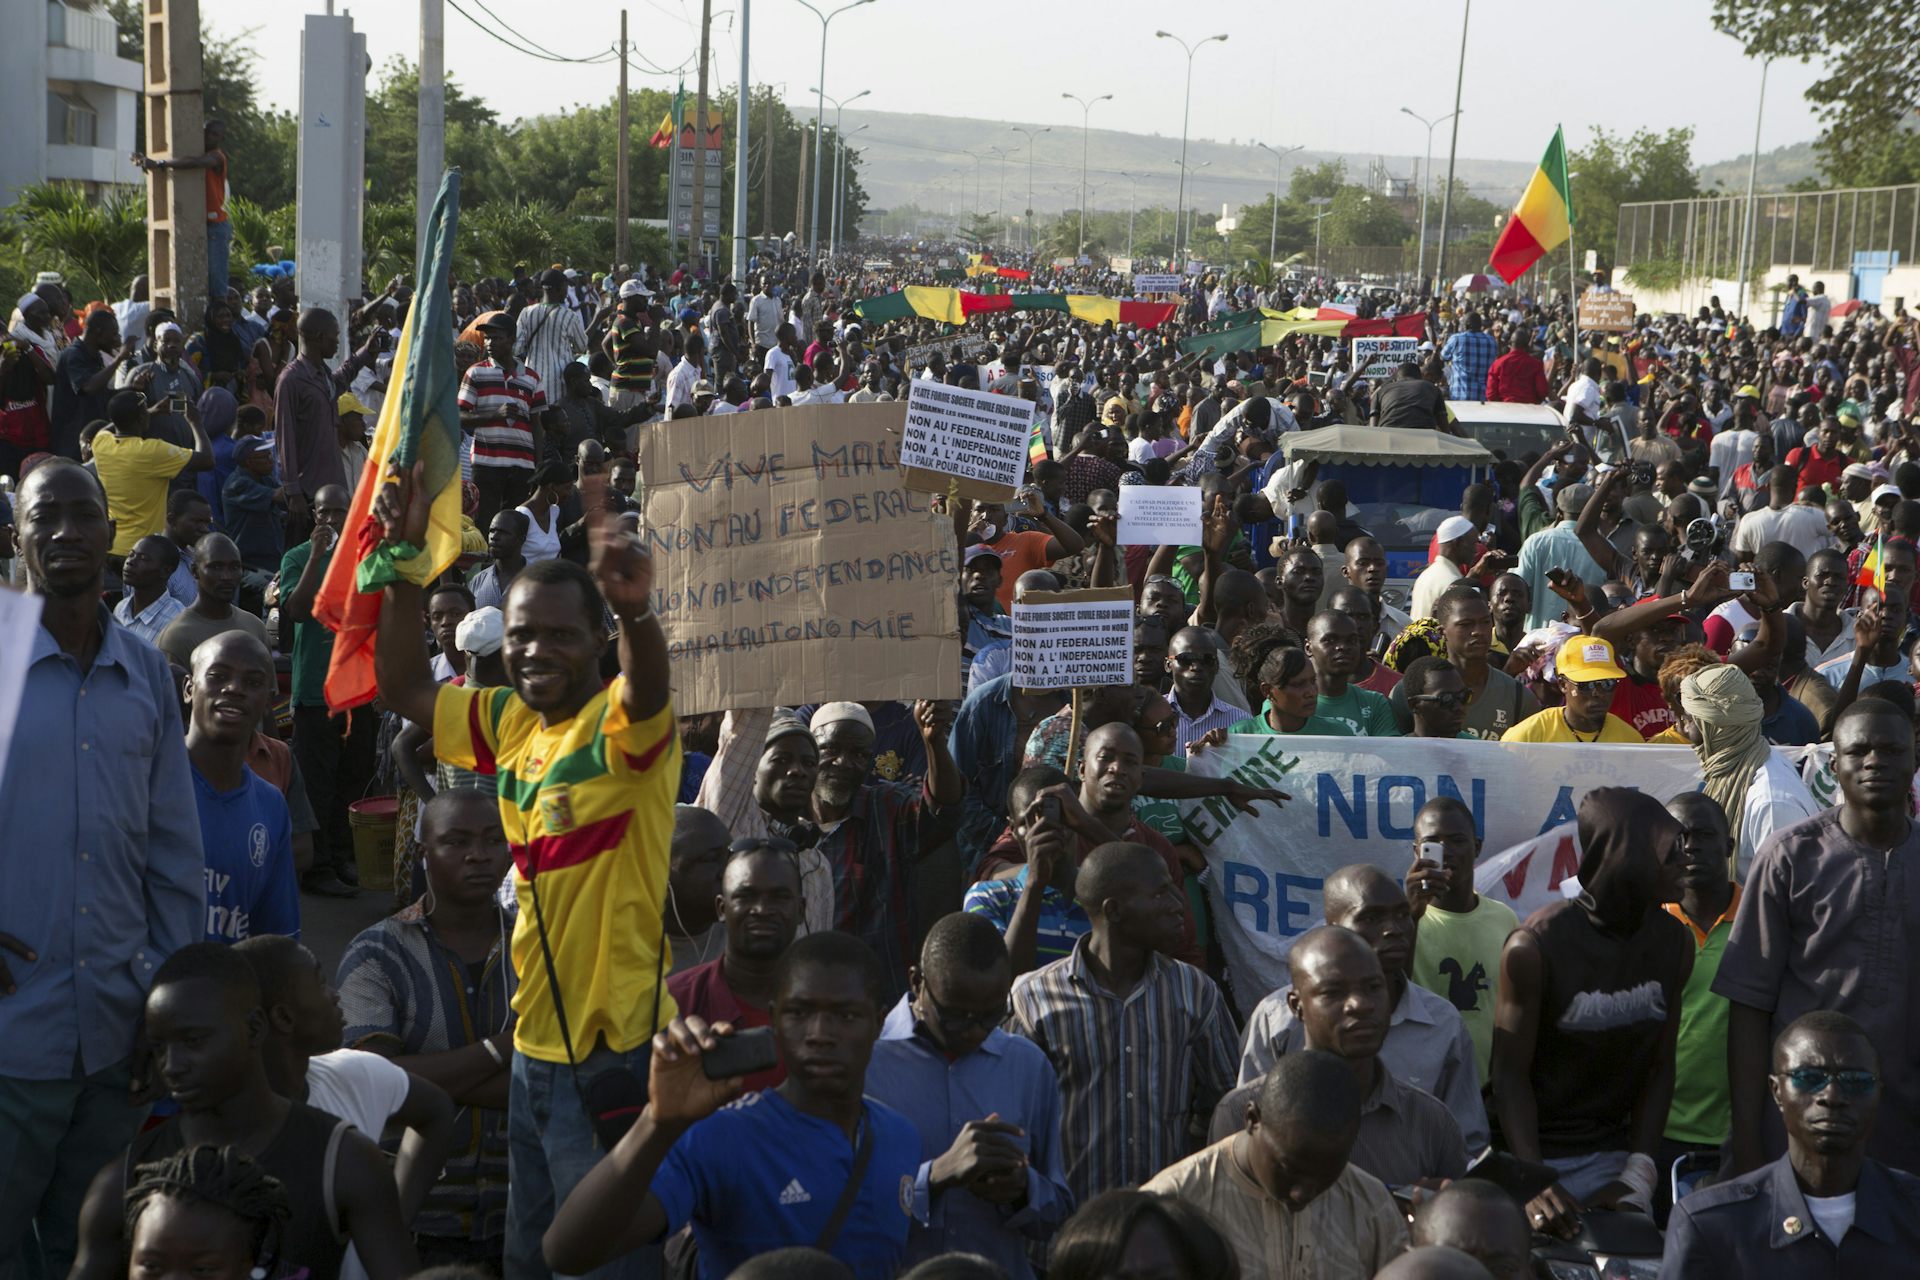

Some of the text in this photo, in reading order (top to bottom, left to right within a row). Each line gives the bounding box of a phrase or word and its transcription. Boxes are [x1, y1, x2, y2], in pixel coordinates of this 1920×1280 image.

[1357, 341, 1379, 352] PAS
[1379, 341, 1390, 352] DE
[1366, 367, 1387, 376] NORD
[913, 386, 931, 400] PLATE
[976, 399, 996, 413] CIVILE
[908, 414, 1022, 448] NON AU FEDERALISME
[946, 409, 957, 417] LES
[1008, 423, 1027, 434] NORD
[906, 427, 927, 441] NON
[930, 433, 937, 444] A
[951, 437, 1021, 462] INDEPENDANCE
[904, 440, 927, 454] NON
[931, 446, 939, 457] A
[955, 451, 1017, 474] AUTONOMIE
[914, 454, 934, 469] PAIX
[935, 459, 959, 473] POUR
[960, 465, 976, 477] LES
[977, 469, 1015, 485] MALIENS
[1077, 610, 1096, 620] CIVILE
[1111, 623, 1129, 632] NORD
[669, 634, 702, 663] ON
[1014, 636, 1126, 649] NON AU FEDERALISME
[1014, 651, 1034, 662] NON
[1038, 653, 1045, 662] A
[1059, 649, 1127, 661] INDEPENDANCE
[1014, 664, 1036, 675] NON
[1041, 665, 1049, 675] A
[1065, 662, 1125, 674] AUTONOMIE
[1026, 676, 1045, 687] PAIX
[1047, 676, 1070, 686] POUR
[1071, 675, 1087, 685] LES
[1088, 674, 1125, 684] MALIENS
[1316, 772, 1486, 841] NON
